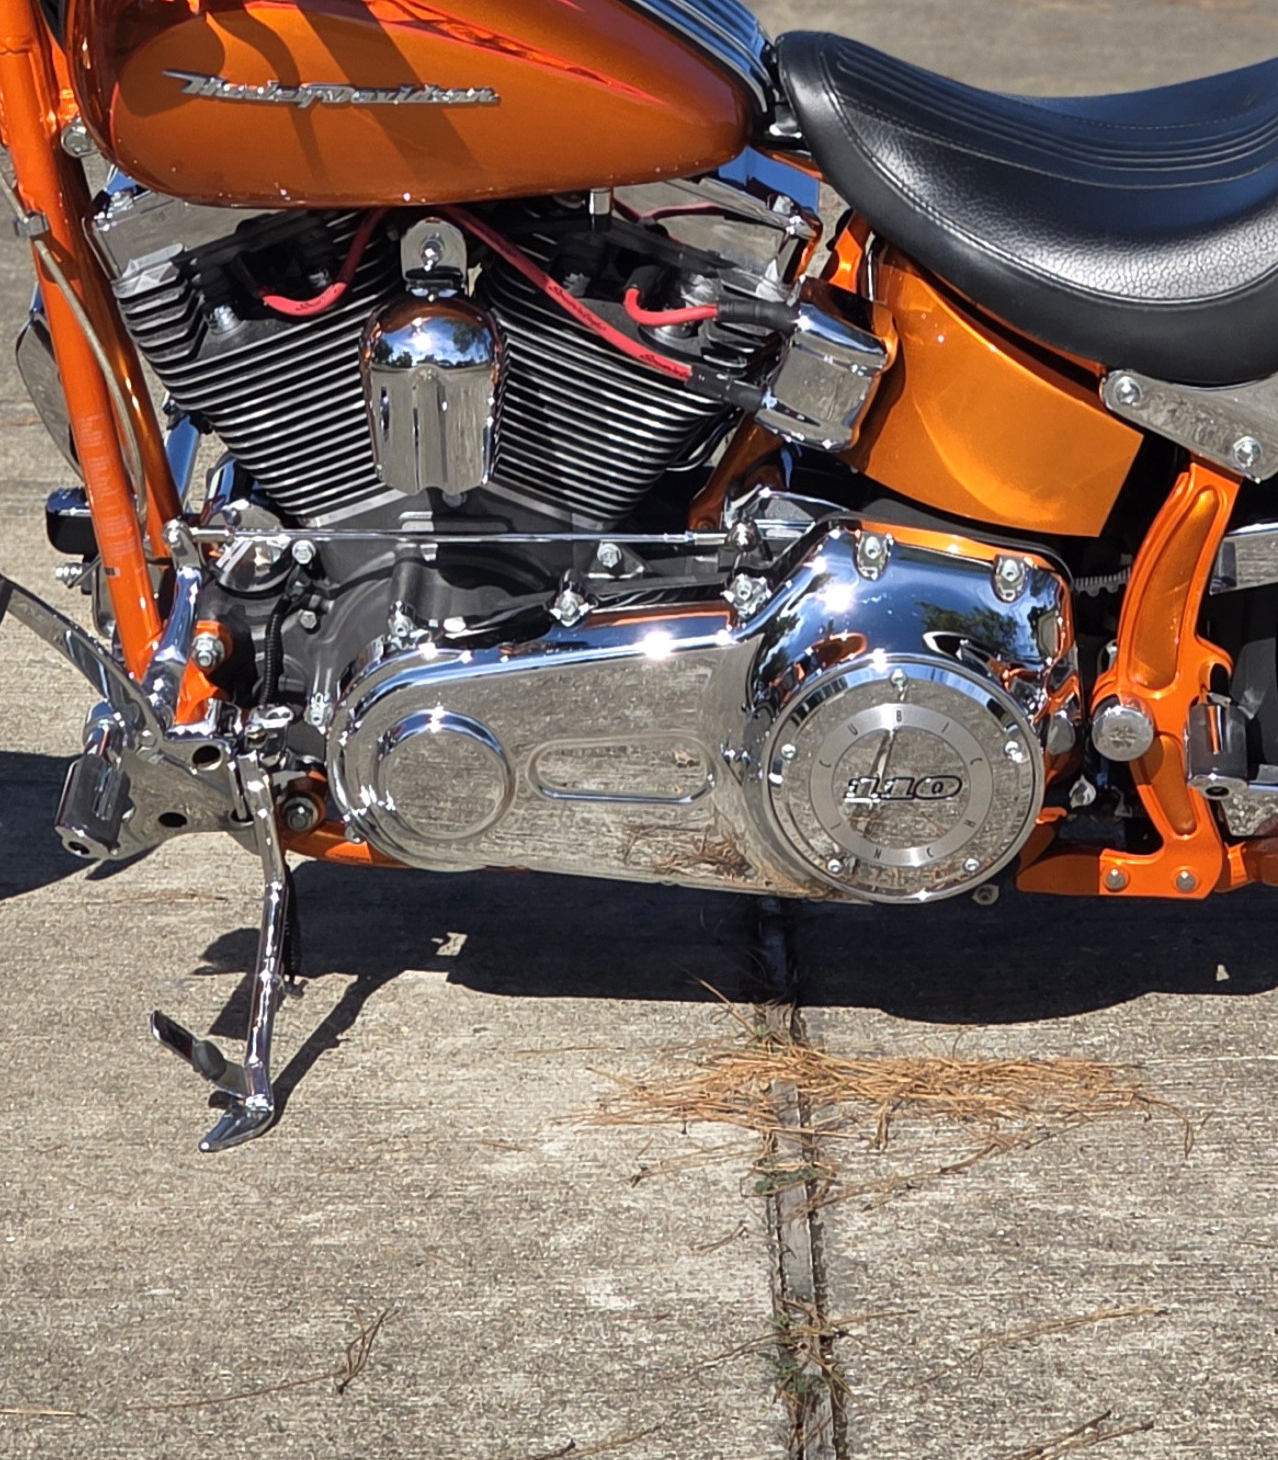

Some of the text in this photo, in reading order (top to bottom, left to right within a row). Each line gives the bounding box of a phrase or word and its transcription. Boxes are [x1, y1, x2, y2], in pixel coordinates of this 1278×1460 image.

[818, 709, 984, 769] CUBIC
[843, 775, 963, 802] 110
[829, 817, 977, 861] INCH
